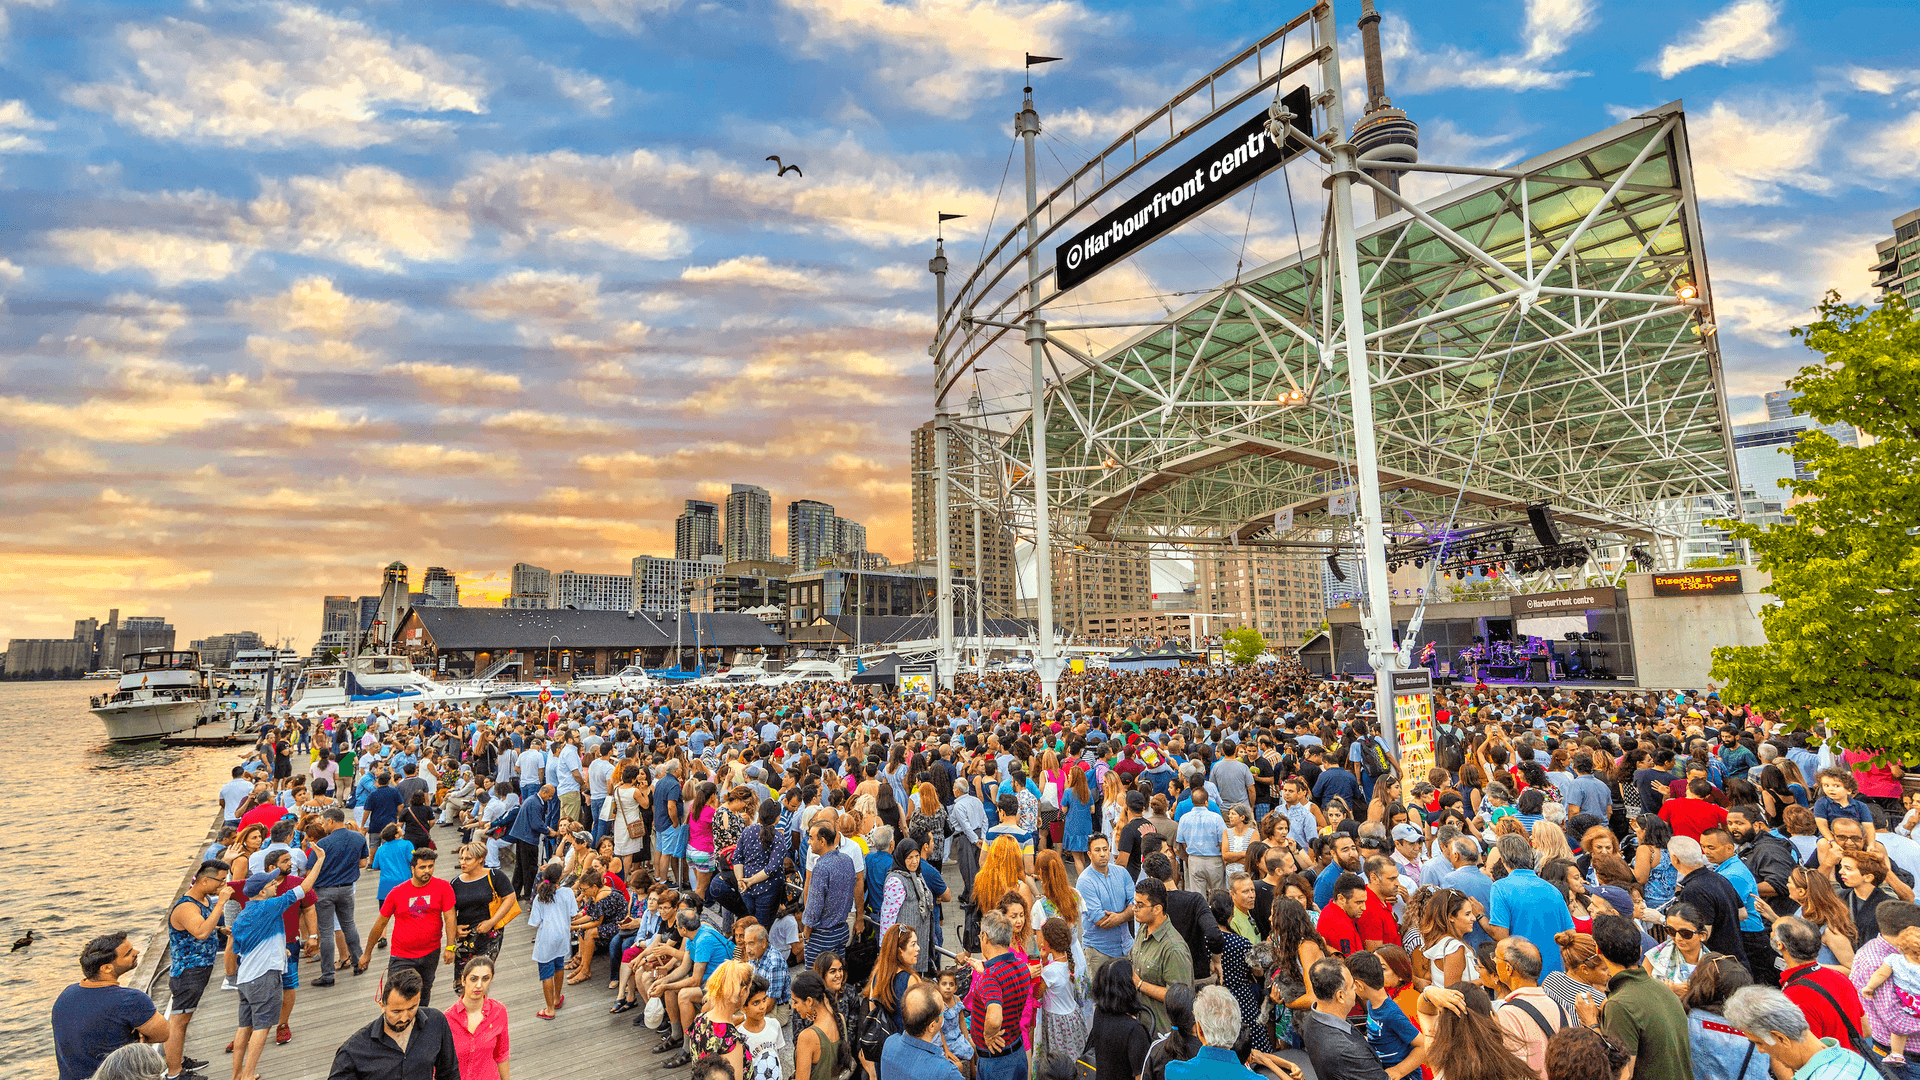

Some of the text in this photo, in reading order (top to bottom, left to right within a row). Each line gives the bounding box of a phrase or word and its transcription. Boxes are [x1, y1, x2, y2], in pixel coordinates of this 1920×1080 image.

[1084, 129, 1277, 260] Harbourfront centr
[1655, 574, 1738, 586] Ensemble Topaz
[1680, 582, 1714, 591] 1:30pm
[1533, 595, 1595, 608] Harbourfront centre
